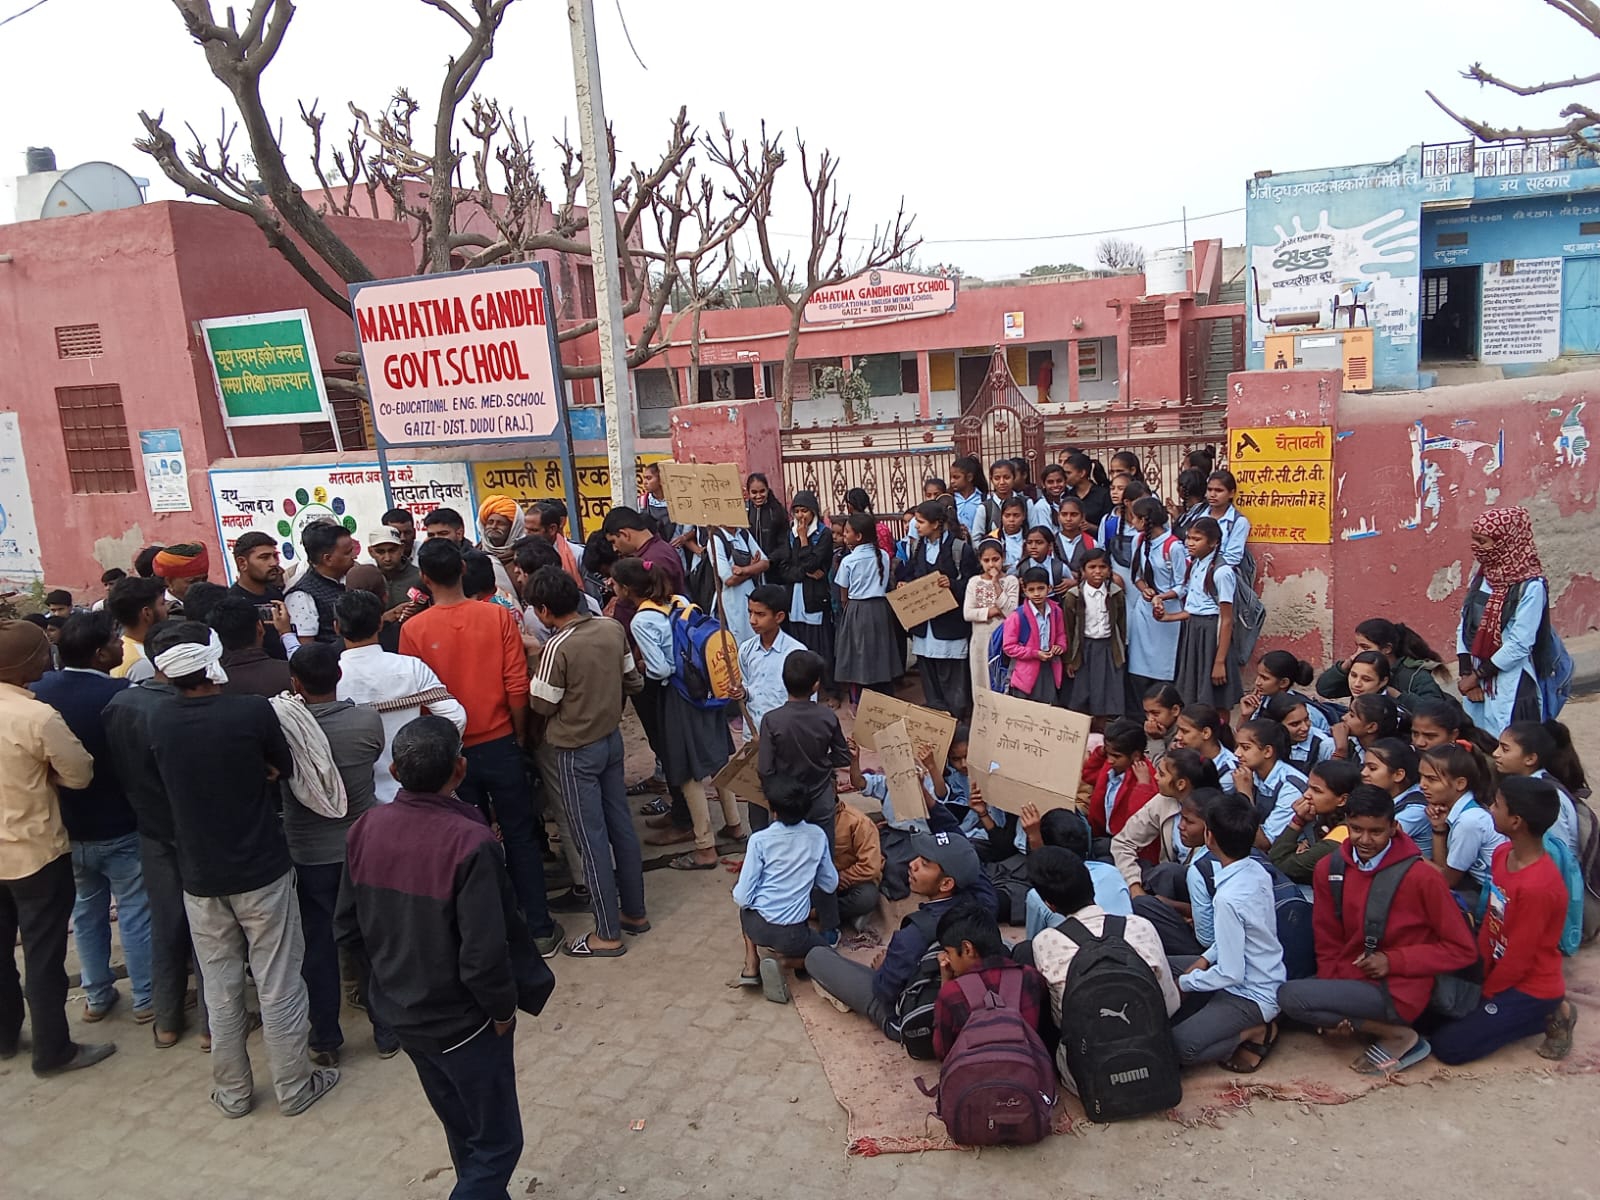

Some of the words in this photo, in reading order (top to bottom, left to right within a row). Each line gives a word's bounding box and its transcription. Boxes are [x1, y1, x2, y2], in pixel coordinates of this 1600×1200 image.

[1500, 179, 1519, 192] जय
[1526, 174, 1571, 191] सहकार
[808, 290, 854, 304] MAHATMA
[858, 284, 891, 299] GANDHI
[918, 279, 950, 293] SCHOOL
[912, 294, 933, 302] SCHOOL
[356, 297, 470, 343] MAHATMA
[471, 288, 546, 332] GANDHI
[383, 349, 449, 390] GOVT.
[449, 340, 529, 386] SCHOOL
[243, 370, 266, 395] शिक्षा
[380, 398, 448, 415] CO-EDUCATIONAL
[453, 396, 477, 411] ENG.
[507, 391, 546, 407] SCHOOL
[470, 417, 495, 433] DUDU
[1275, 431, 1325, 452] चेतावनी
[329, 471, 363, 486] मतदान
[483, 462, 538, 489] अपनी
[545, 461, 561, 491] ही
[1237, 470, 1256, 484] आप
[430, 480, 463, 502] दिवस
[1258, 491, 1269, 507] की
[1271, 489, 1308, 507] निगरानी
[222, 515, 253, 530] मतदान
